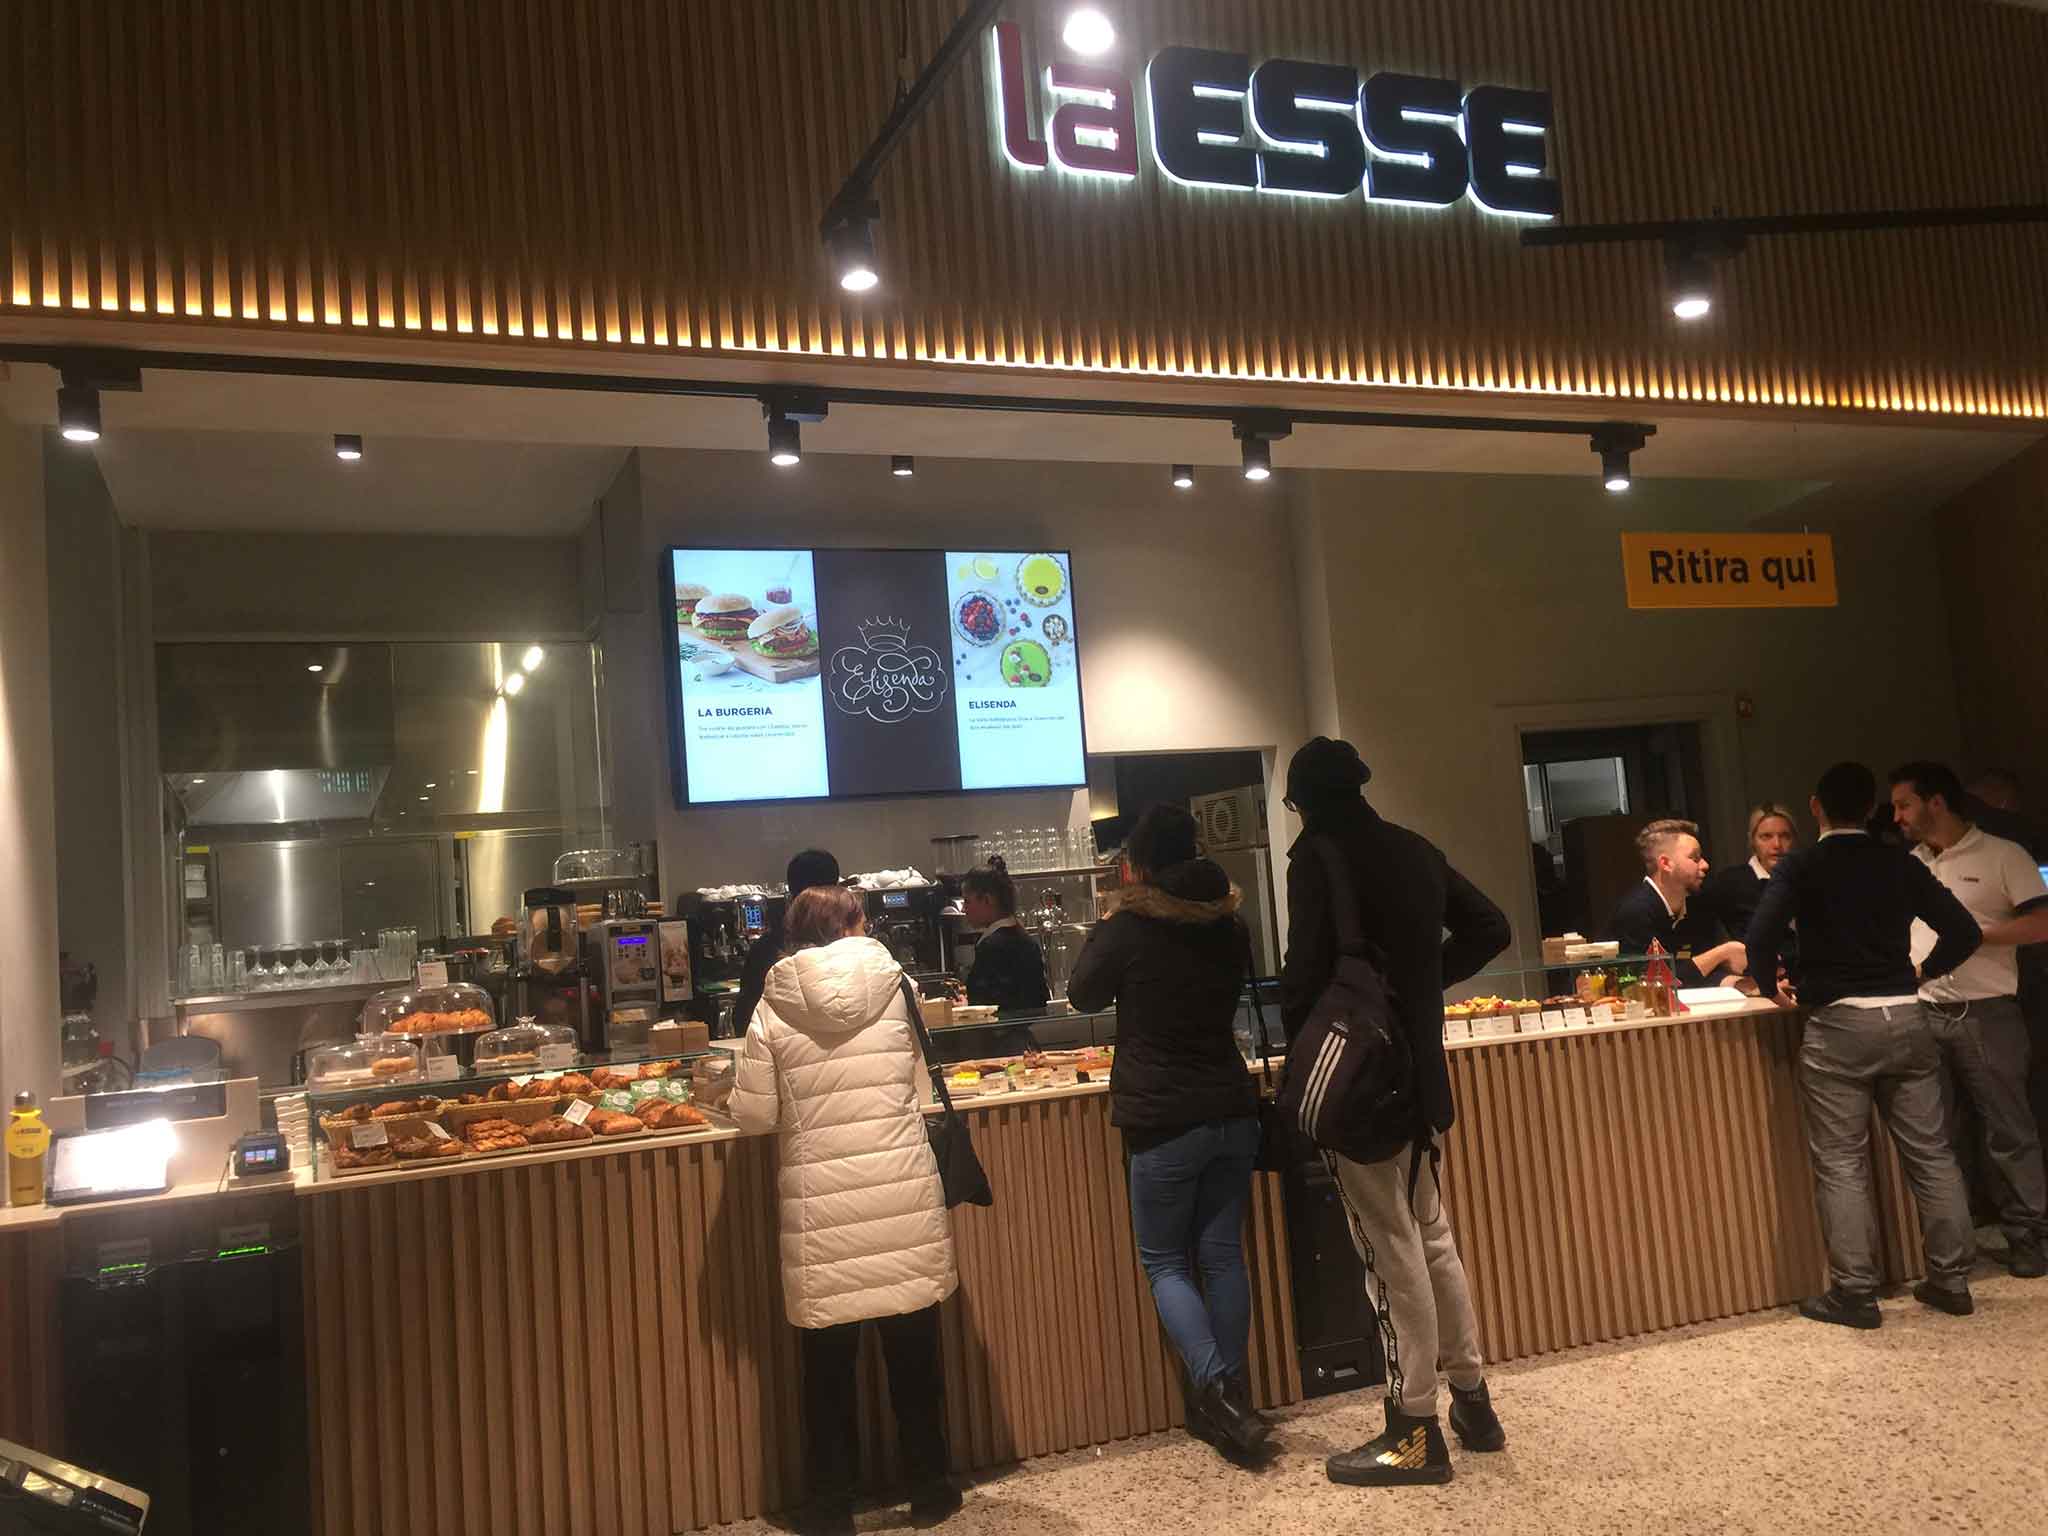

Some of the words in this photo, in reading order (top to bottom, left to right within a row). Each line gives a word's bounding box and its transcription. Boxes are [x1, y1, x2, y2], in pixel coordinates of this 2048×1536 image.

[1648, 548, 1749, 585] Ritira
[1761, 548, 1817, 591] qui
[842, 653, 936, 713] Elisenda
[698, 708, 713, 718] LA
[716, 706, 773, 717] BURGERIA
[968, 700, 1017, 710] ELISENDA
